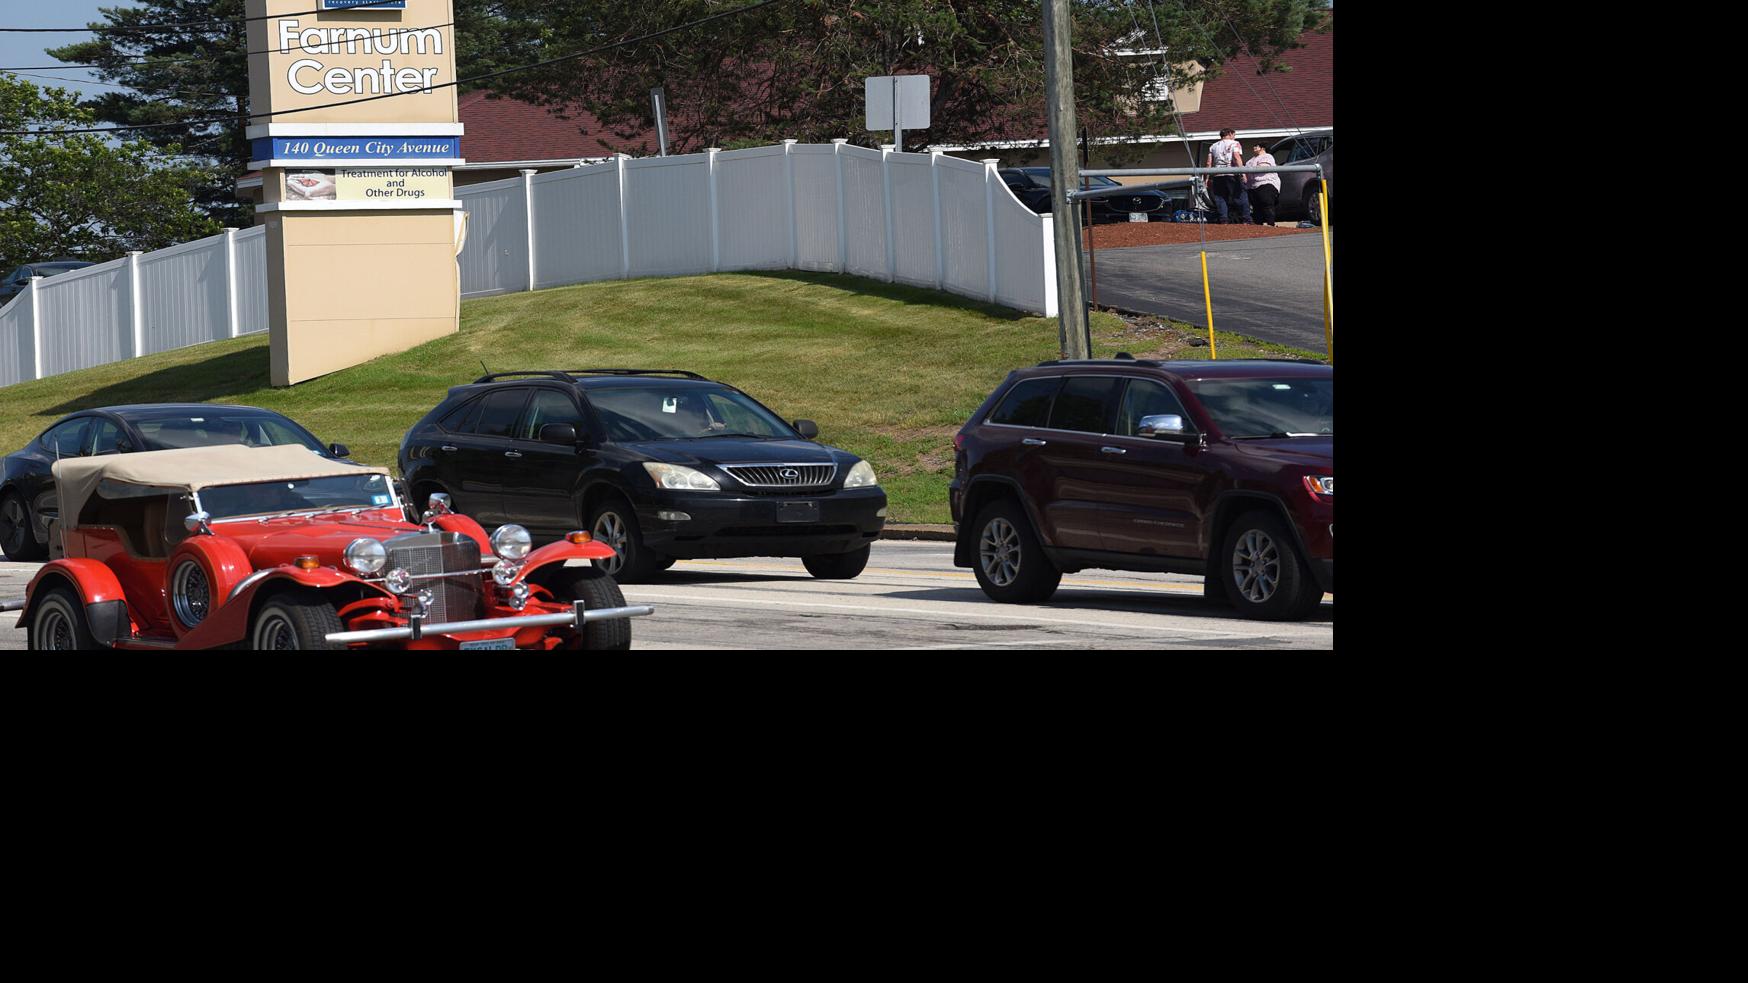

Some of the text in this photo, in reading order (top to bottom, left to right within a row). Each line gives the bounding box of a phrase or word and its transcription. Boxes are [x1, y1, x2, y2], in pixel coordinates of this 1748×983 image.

[278, 19, 443, 55] Farnum
[287, 58, 439, 95] Center
[283, 141, 450, 157] 140 Queen City Avenue
[341, 168, 447, 178] Treatment for Alcohol
[386, 179, 405, 187] and
[365, 188, 425, 198] Other Drugs
